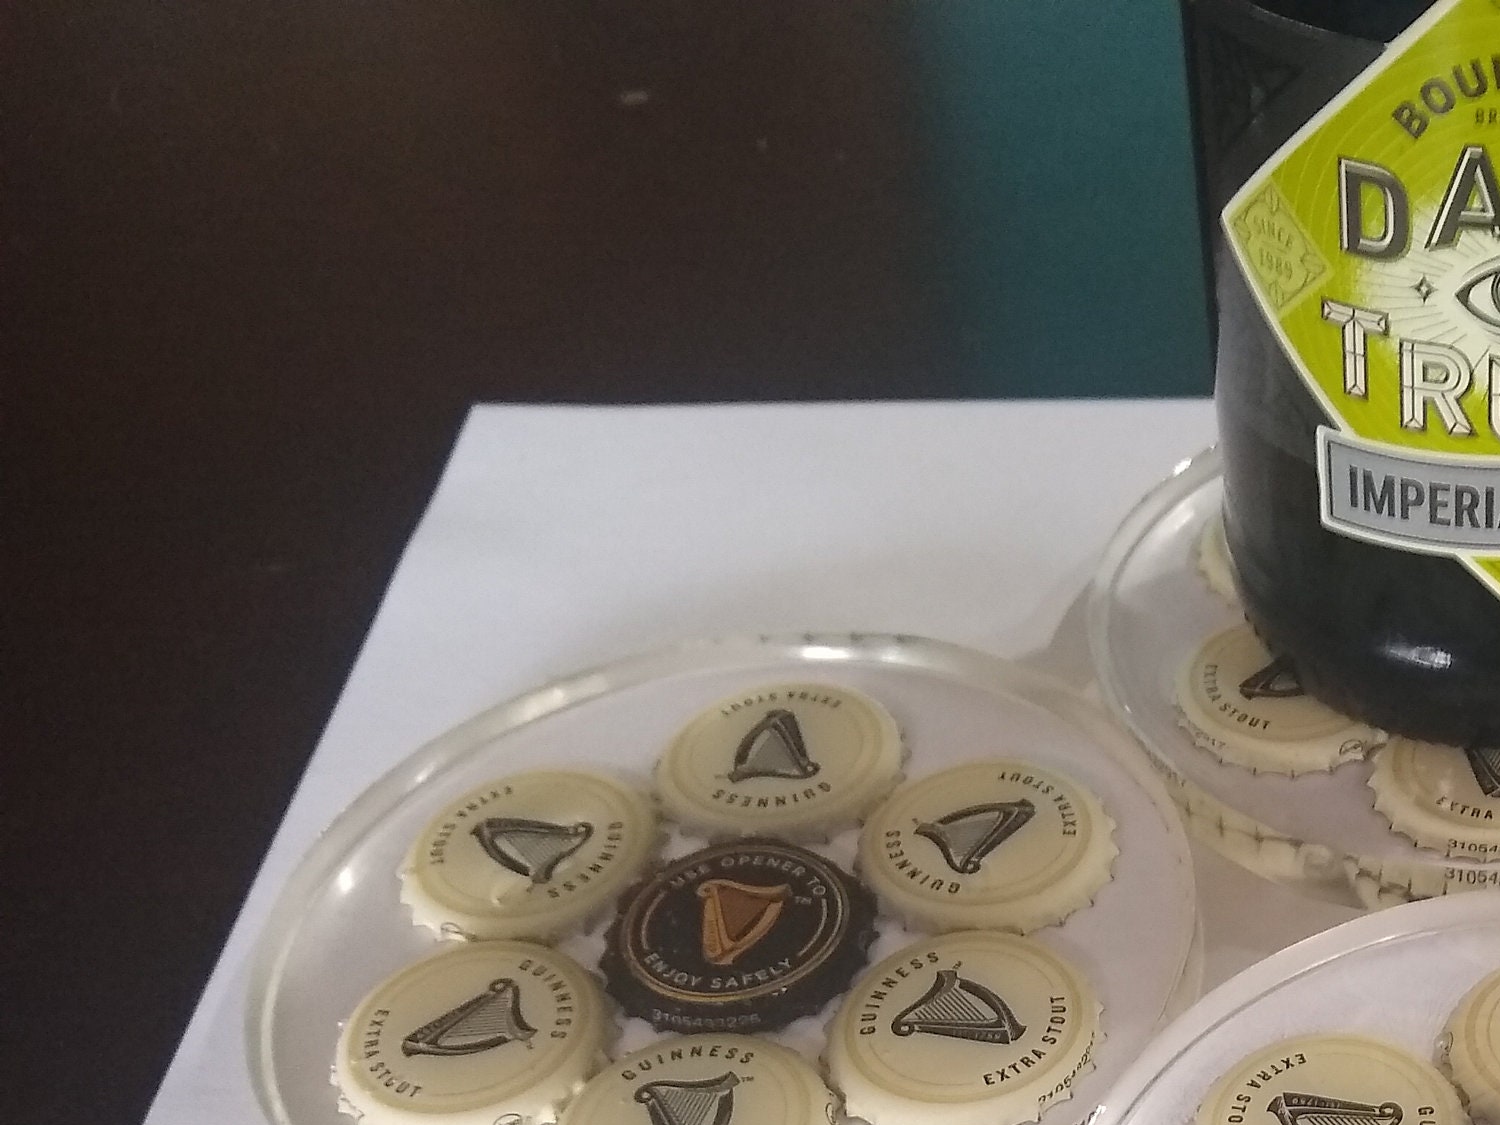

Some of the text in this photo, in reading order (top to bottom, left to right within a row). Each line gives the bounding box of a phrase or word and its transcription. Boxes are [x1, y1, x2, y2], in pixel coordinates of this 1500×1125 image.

[1219, 703, 1271, 730] STOUT
[999, 771, 1077, 837] EXTRA STOUT
[721, 856, 806, 876] OPENER
[806, 876, 827, 896] TO
[885, 830, 960, 894] GUINNESS
[519, 959, 573, 1039] GUINNESS
[644, 952, 792, 989] ENJOY SAFELY
[860, 952, 939, 1035] GUINNESS
[364, 1009, 422, 1097] EXTRA STOUT
[621, 1045, 754, 1081] GUINNESS
[983, 996, 1066, 1085] EXTRA STOUT
[1246, 1053, 1307, 1089] EXTRA
